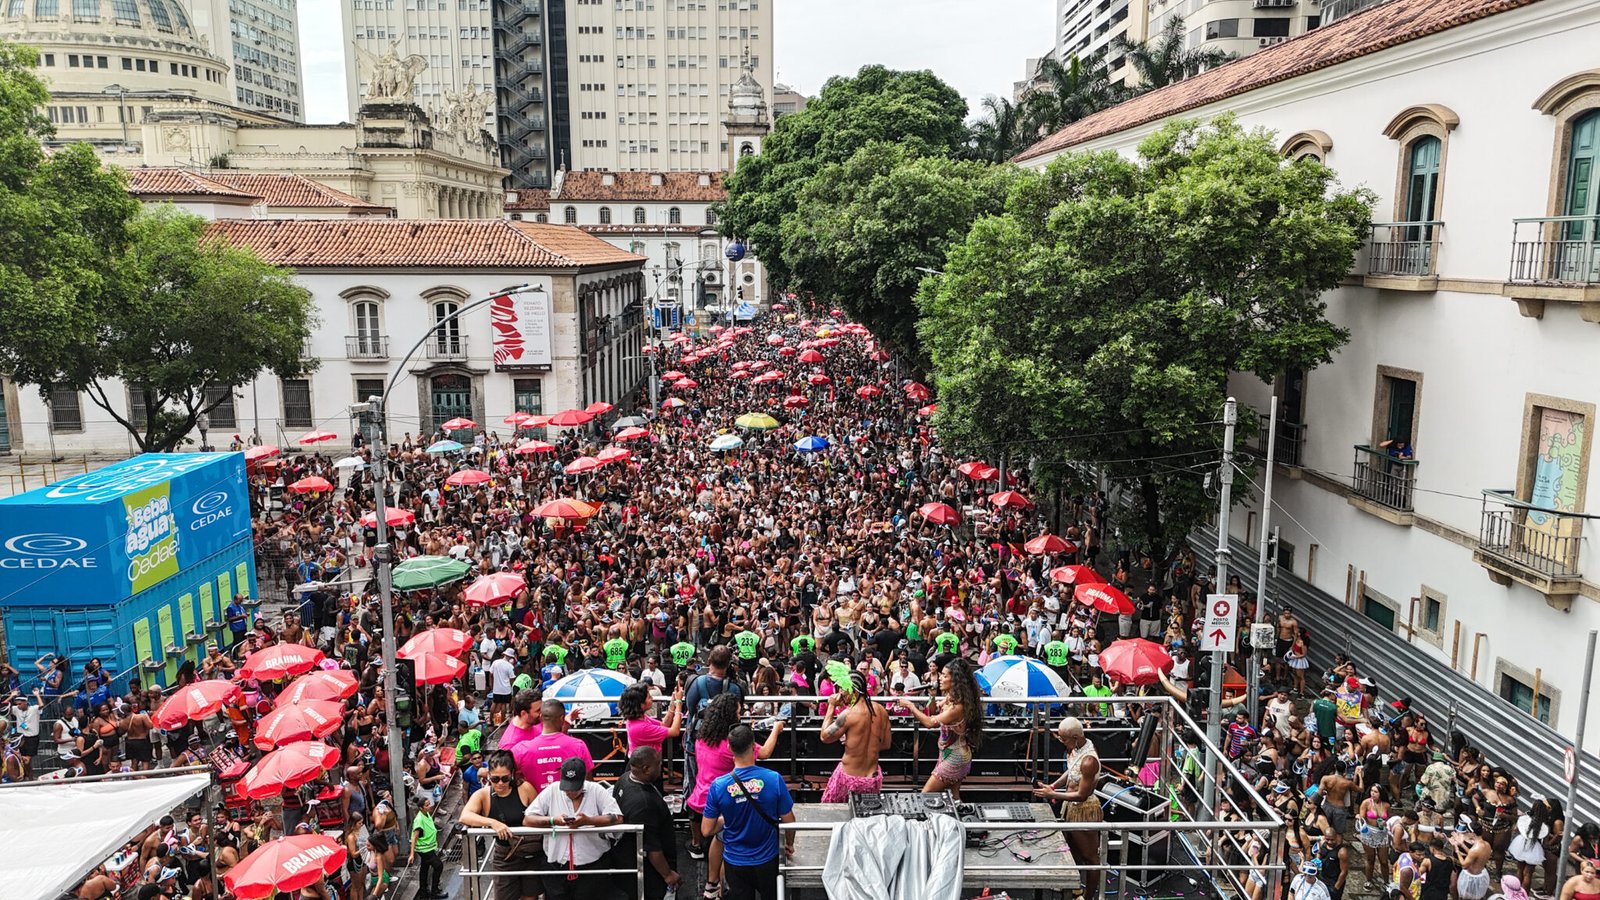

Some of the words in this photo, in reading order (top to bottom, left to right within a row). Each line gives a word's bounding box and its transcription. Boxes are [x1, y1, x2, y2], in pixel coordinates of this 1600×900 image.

[133, 497, 168, 527] Beba
[190, 506, 233, 531] CEDAE
[0, 557, 97, 569] CEDAE
[127, 533, 180, 582] Cedae!
[1085, 588, 1114, 605] BRAHMA
[741, 638, 754, 647] 233
[610, 647, 623, 656] 685
[677, 651, 690, 660] 249
[1050, 648, 1063, 657] 283
[265, 654, 304, 669] BRAHMA
[537, 756, 563, 765] BEATS
[282, 844, 335, 875] BRAHMA
